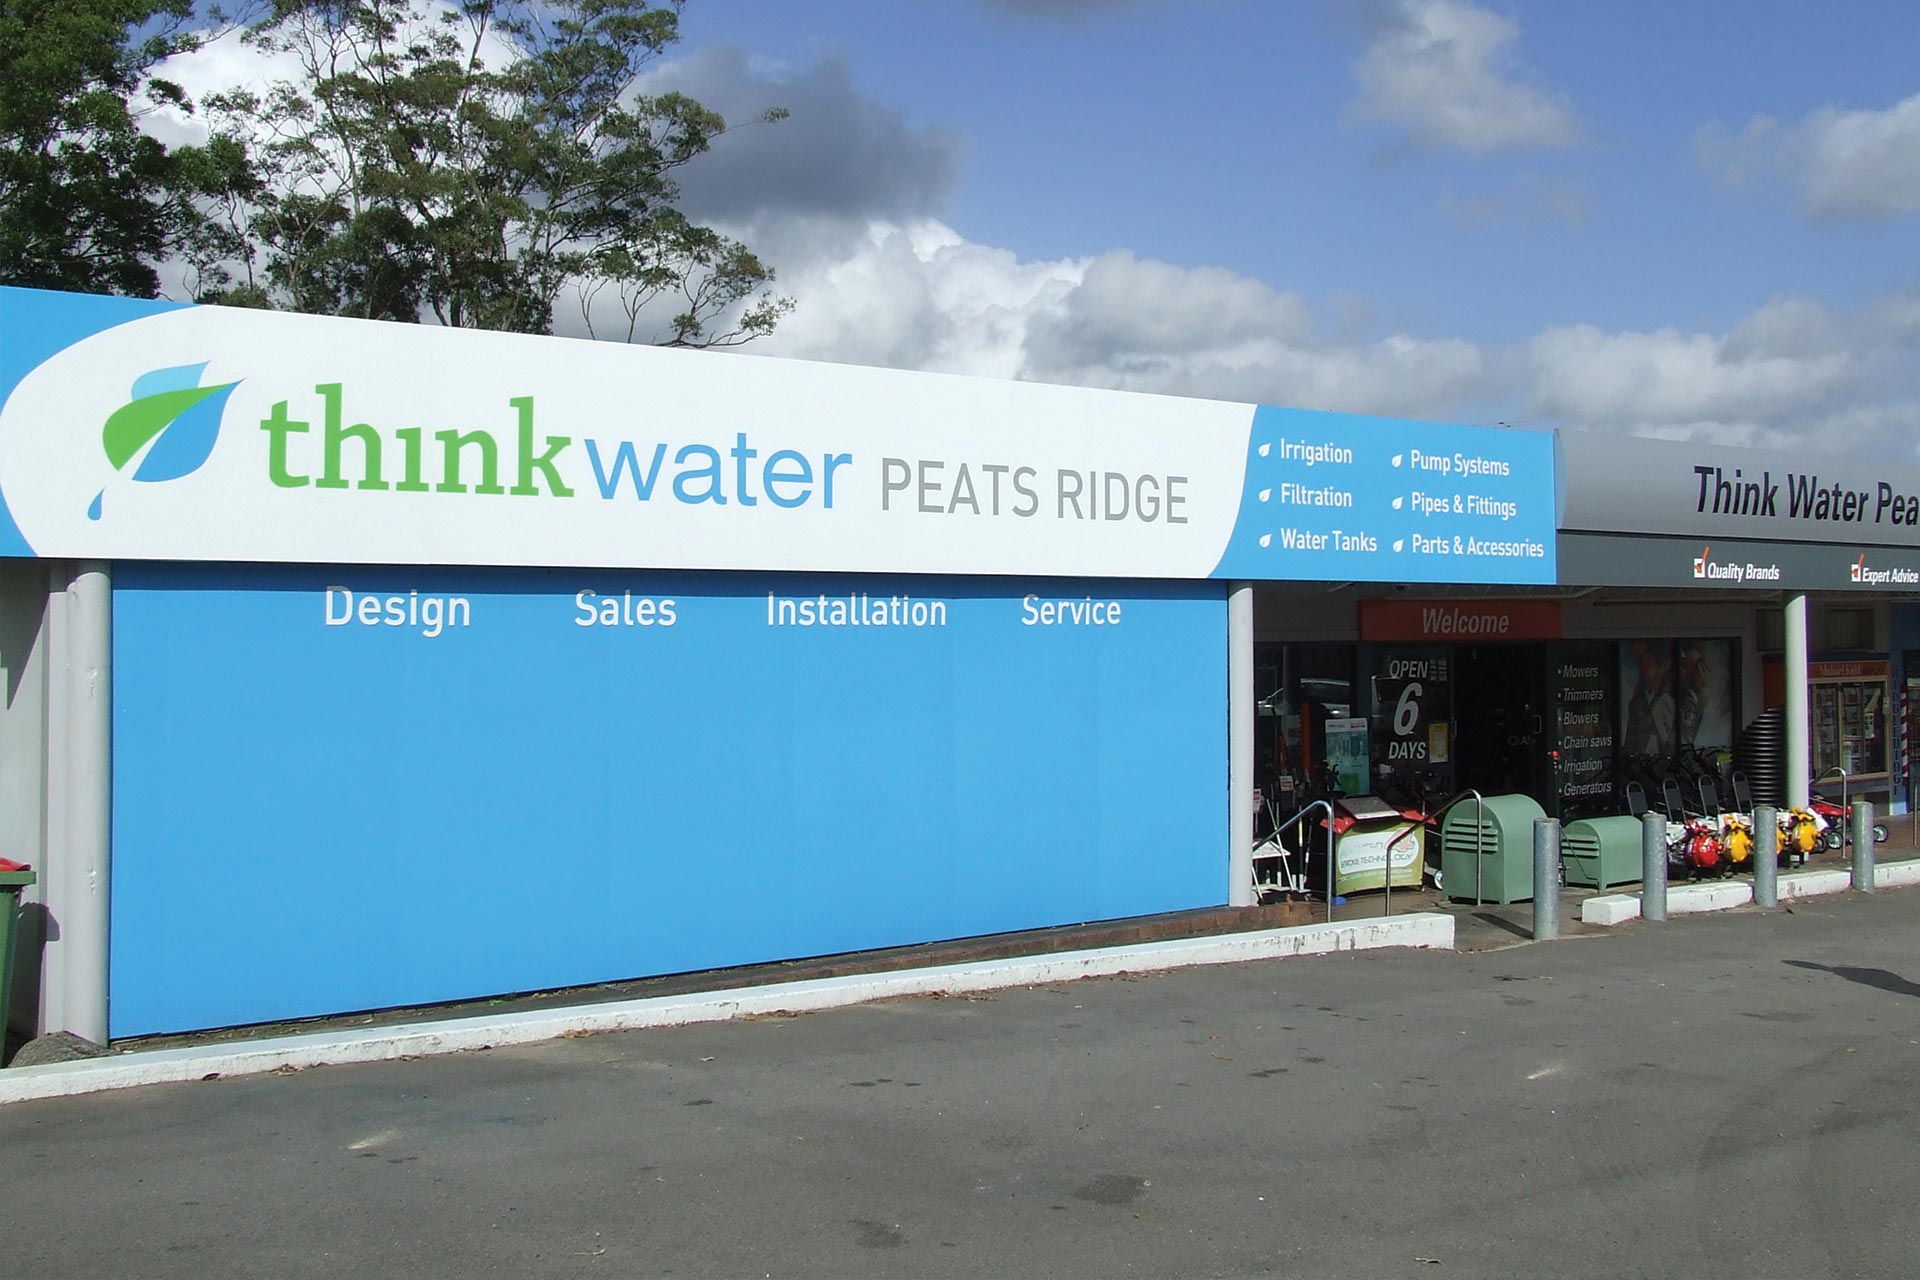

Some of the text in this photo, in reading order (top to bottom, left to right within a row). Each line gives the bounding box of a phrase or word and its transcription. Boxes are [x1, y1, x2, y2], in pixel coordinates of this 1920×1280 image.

[1280, 437, 1353, 467] Irrigation
[1411, 449, 1510, 478] Pump Systems
[881, 457, 1039, 518] PEATS
[1057, 468, 1189, 525] RIDGE
[1281, 482, 1353, 508] Filtration
[1694, 465, 1779, 518] Think
[1787, 473, 1869, 522] Water
[1411, 491, 1517, 519] Pipes & Fittings
[1281, 527, 1378, 552] Water Tanks
[1412, 533, 1544, 558] Parts & Accessories
[1707, 562, 1781, 583] Quality Brands
[1862, 567, 1919, 585] Expert Advice
[324, 586, 471, 638] Design
[574, 589, 677, 627] Sales
[767, 591, 947, 627] Installation
[1021, 594, 1122, 626] Service
[1422, 607, 1510, 634] Welcome
[1389, 659, 1428, 679] OPEN
[1562, 664, 1599, 679] Mowers
[1562, 687, 1604, 702] Trimmers
[1393, 682, 1423, 736] 6
[1562, 711, 1599, 726] Blowers
[1388, 741, 1426, 760] DAYS
[1563, 735, 1613, 749] Chain saws
[1563, 757, 1603, 776] Irrigation
[1563, 780, 1613, 797] Generators
